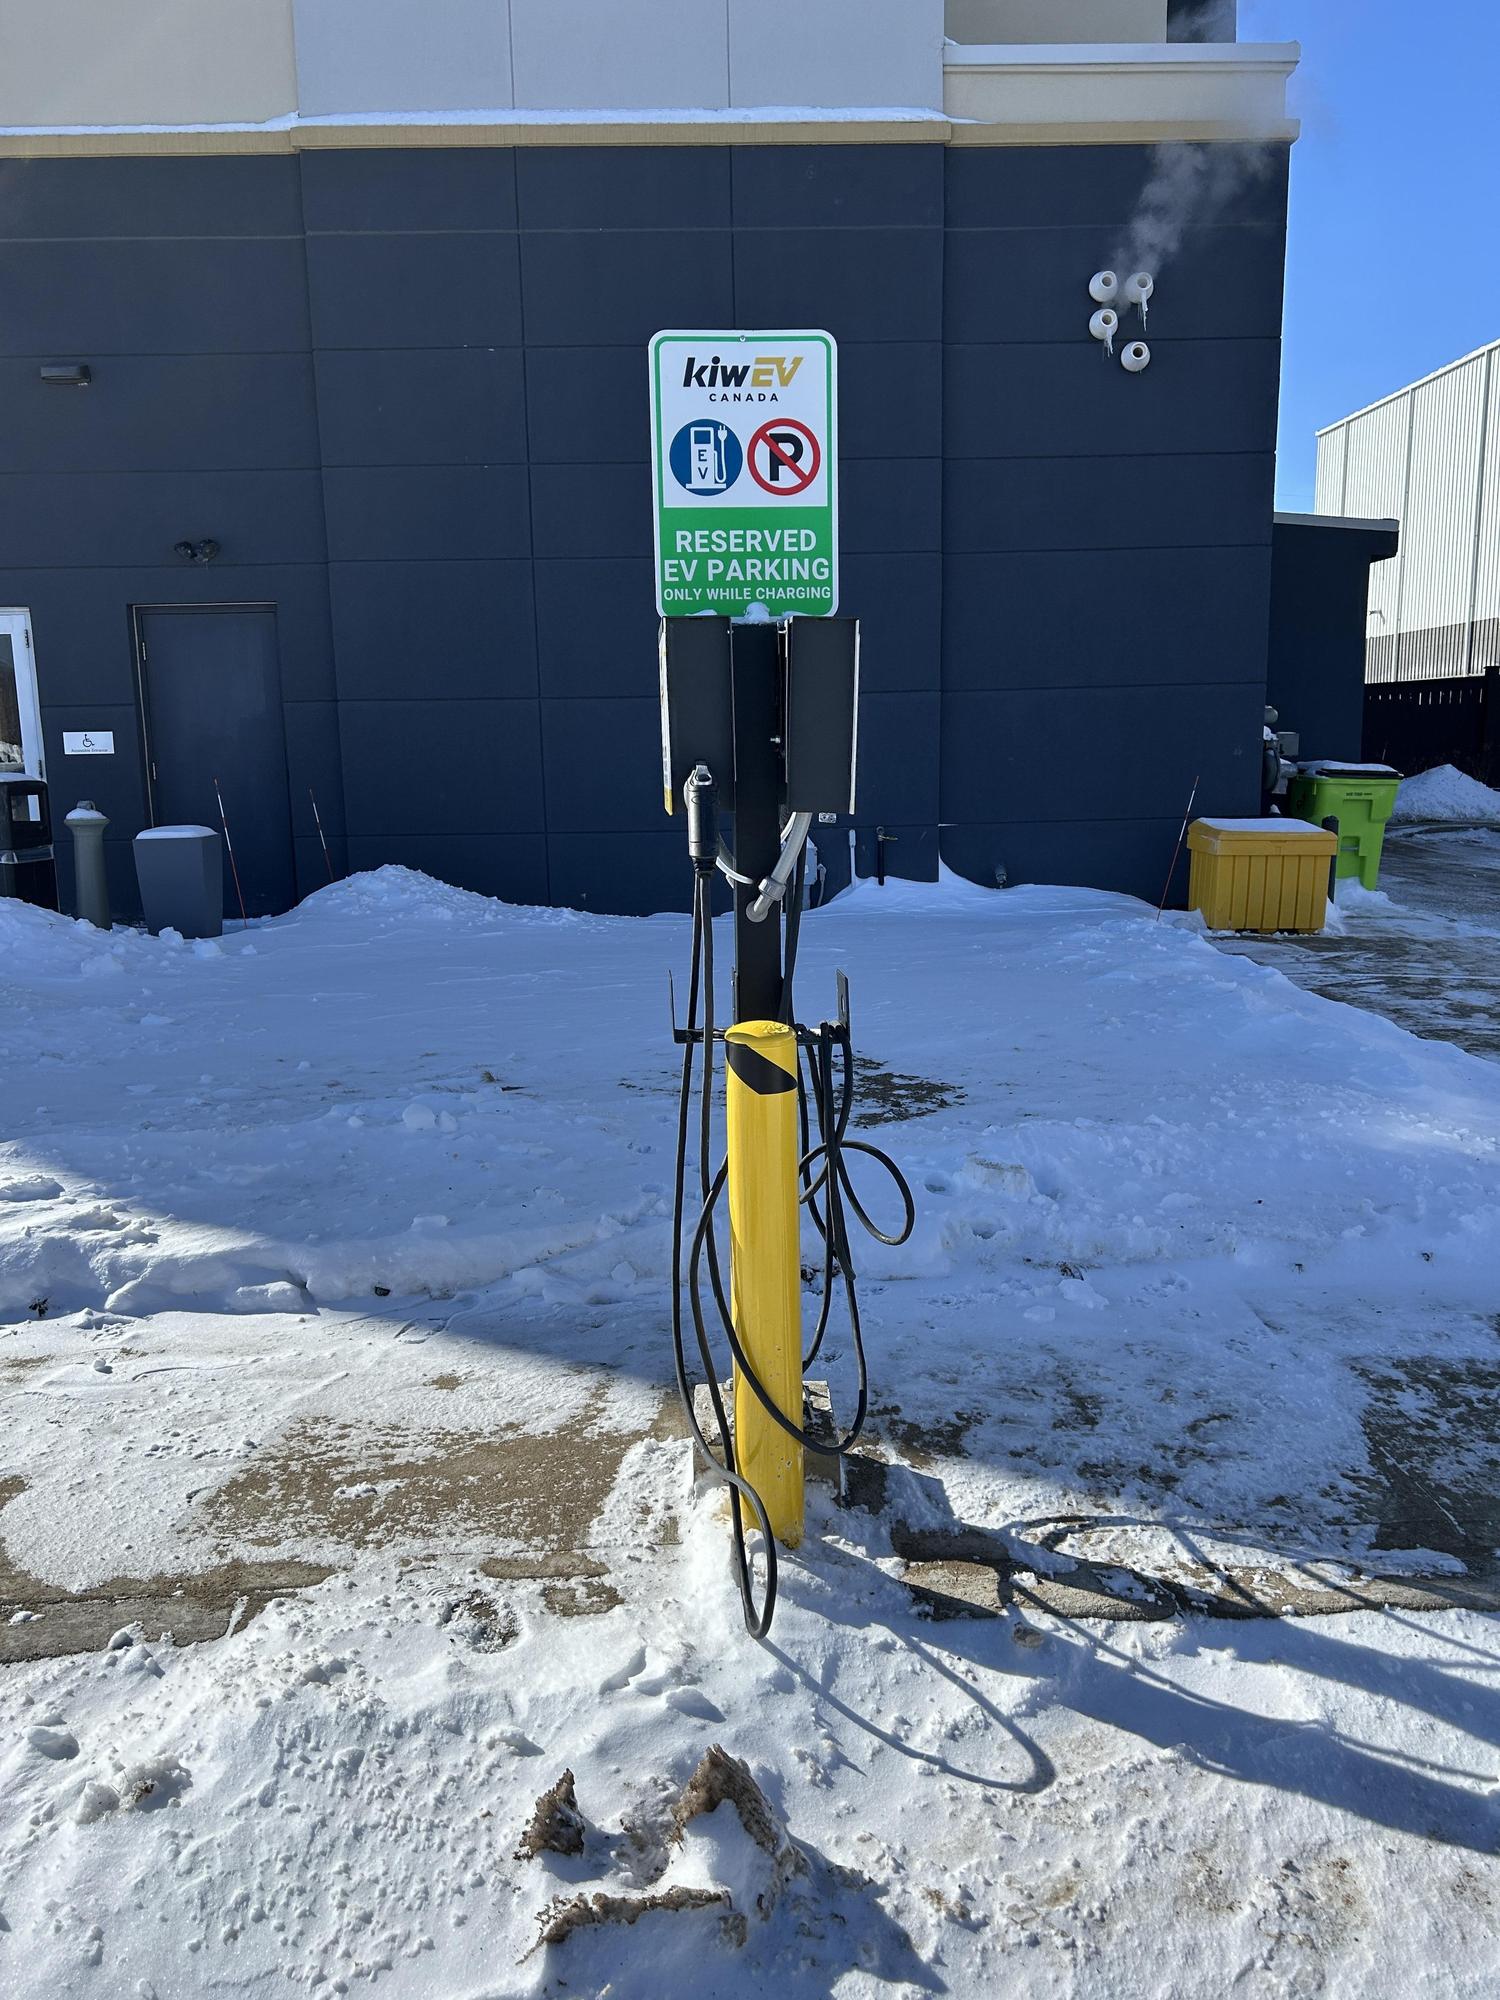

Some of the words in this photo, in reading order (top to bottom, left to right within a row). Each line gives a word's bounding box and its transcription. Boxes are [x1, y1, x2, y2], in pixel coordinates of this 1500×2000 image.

[709, 393, 779, 402] CANADA
[769, 433, 804, 481] P
[677, 529, 817, 553] RESERVED
[664, 559, 698, 582] EV
[707, 557, 830, 582] PARKING
[663, 588, 702, 600] ONLY
[706, 588, 752, 600] WHILE
[755, 586, 831, 599] CHARGING
